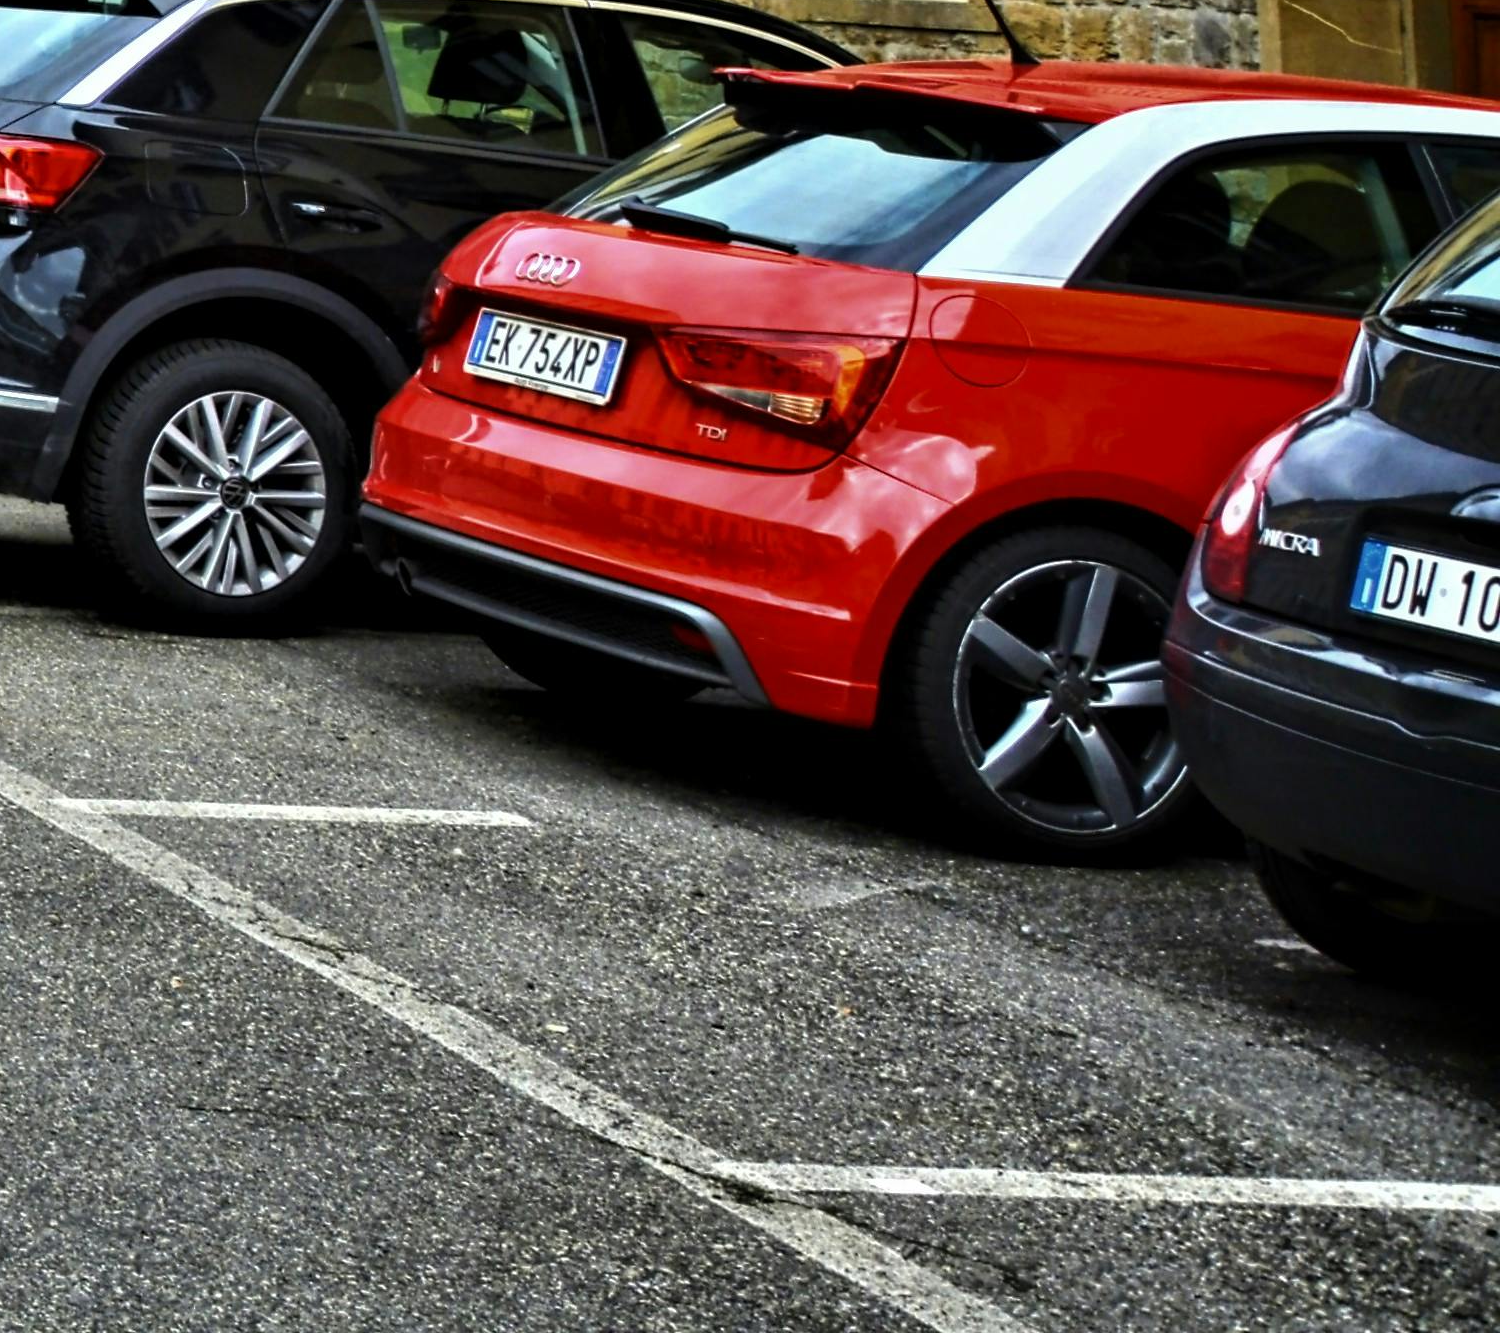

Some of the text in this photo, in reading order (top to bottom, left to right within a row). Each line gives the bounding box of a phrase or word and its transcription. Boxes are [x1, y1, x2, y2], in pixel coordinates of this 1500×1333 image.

[484, 320, 600, 384] EK 754XP
[1258, 528, 1321, 557] MICRA
[1381, 554, 1439, 617] DW
